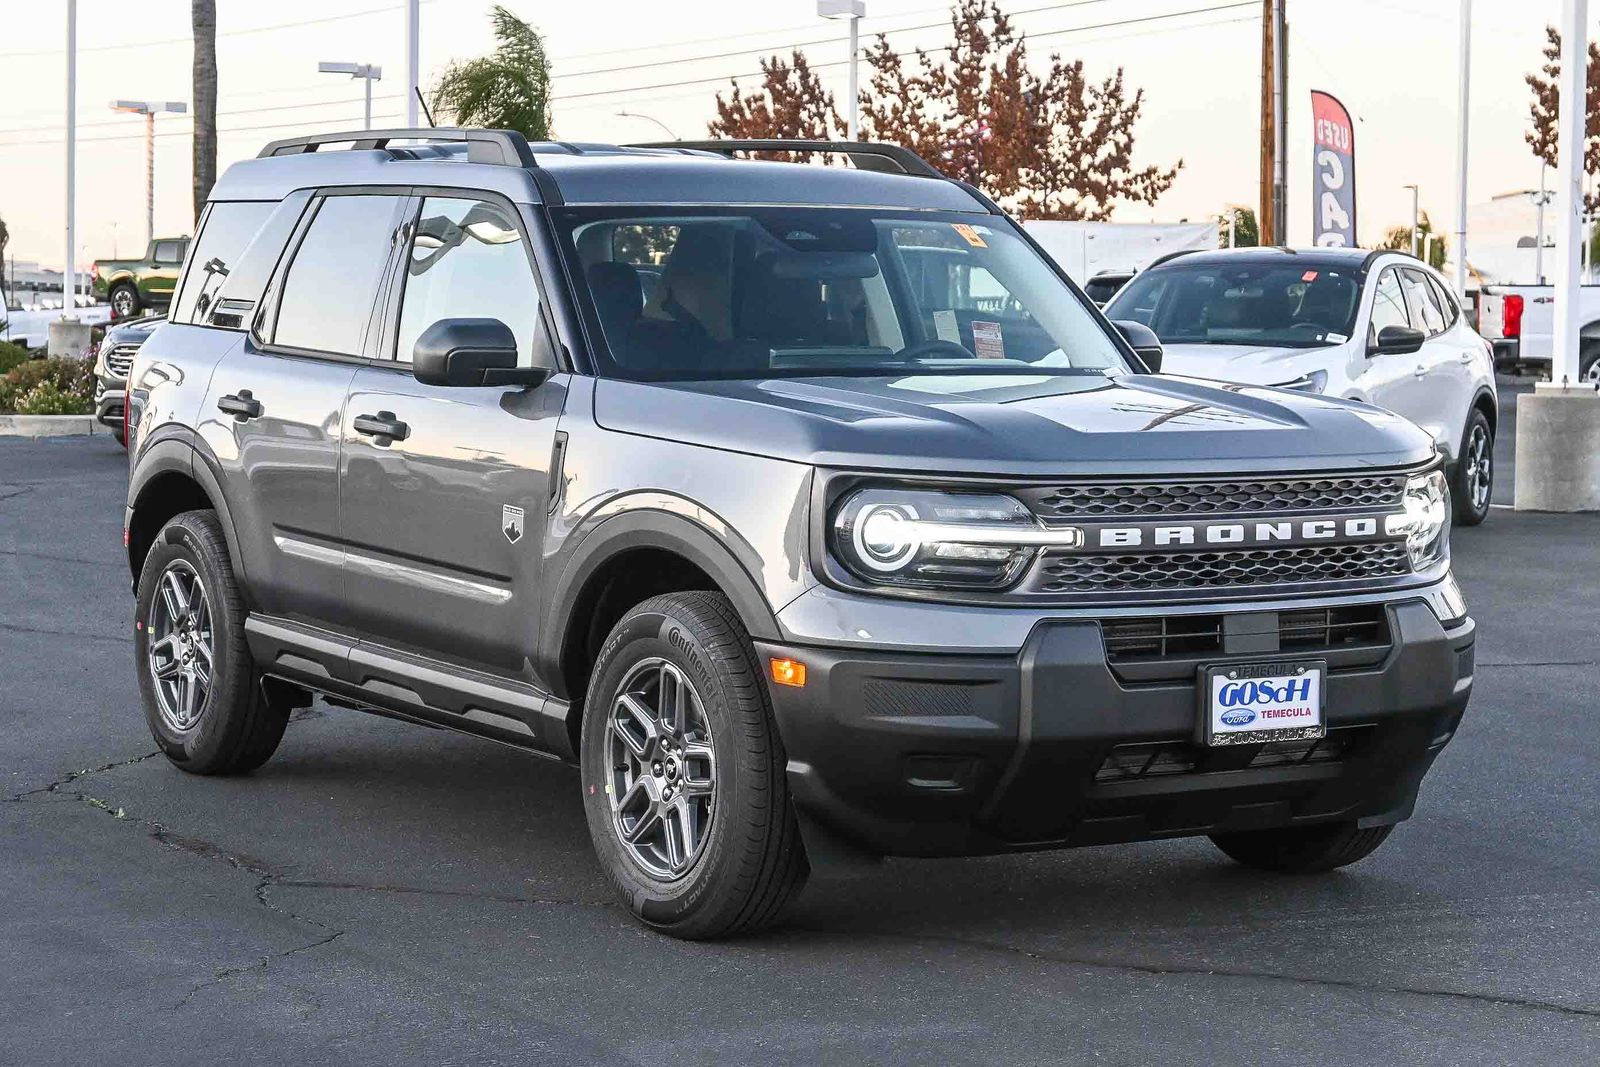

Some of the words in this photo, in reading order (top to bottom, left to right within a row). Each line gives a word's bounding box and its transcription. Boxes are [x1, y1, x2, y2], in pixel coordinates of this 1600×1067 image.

[1100, 518, 1376, 547] BRONCO
[668, 626, 717, 698] Continental
[1239, 664, 1297, 678] TEMECULA
[1226, 712, 1250, 724] Ford
[1261, 707, 1311, 719] TEMECULA
